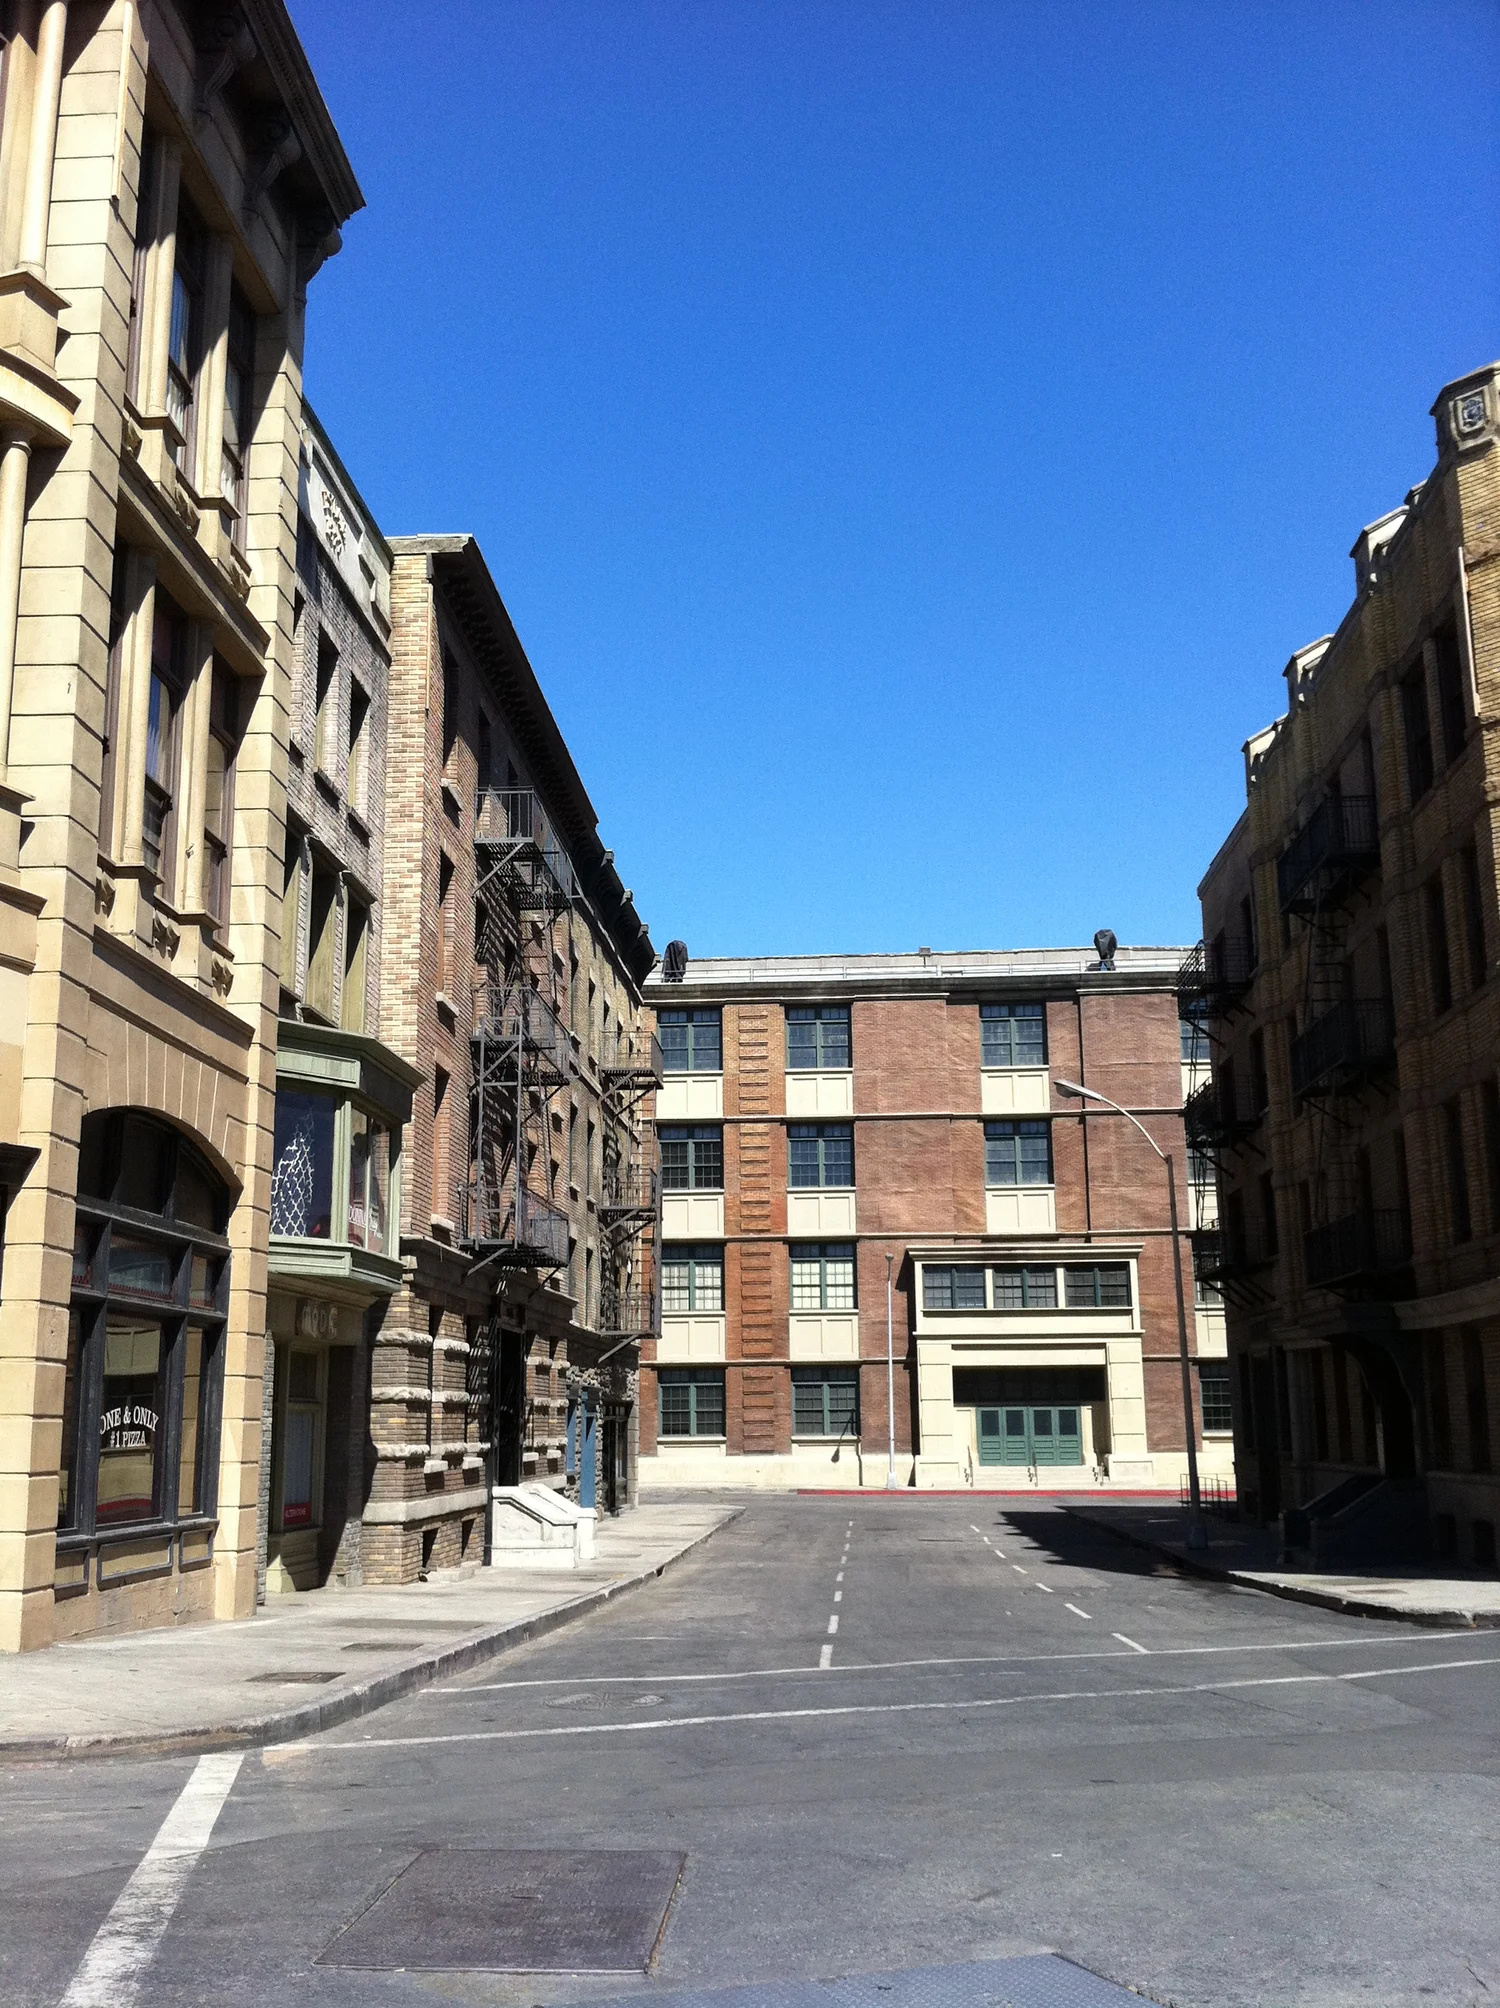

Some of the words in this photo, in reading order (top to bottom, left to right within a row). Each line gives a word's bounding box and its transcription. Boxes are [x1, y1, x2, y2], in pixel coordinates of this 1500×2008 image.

[100, 1407, 121, 1435] ONE
[123, 1405, 131, 1424] &
[133, 1405, 159, 1431] ONLY
[110, 1430, 120, 1448] #1
[122, 1430, 147, 1448] PIZZA
